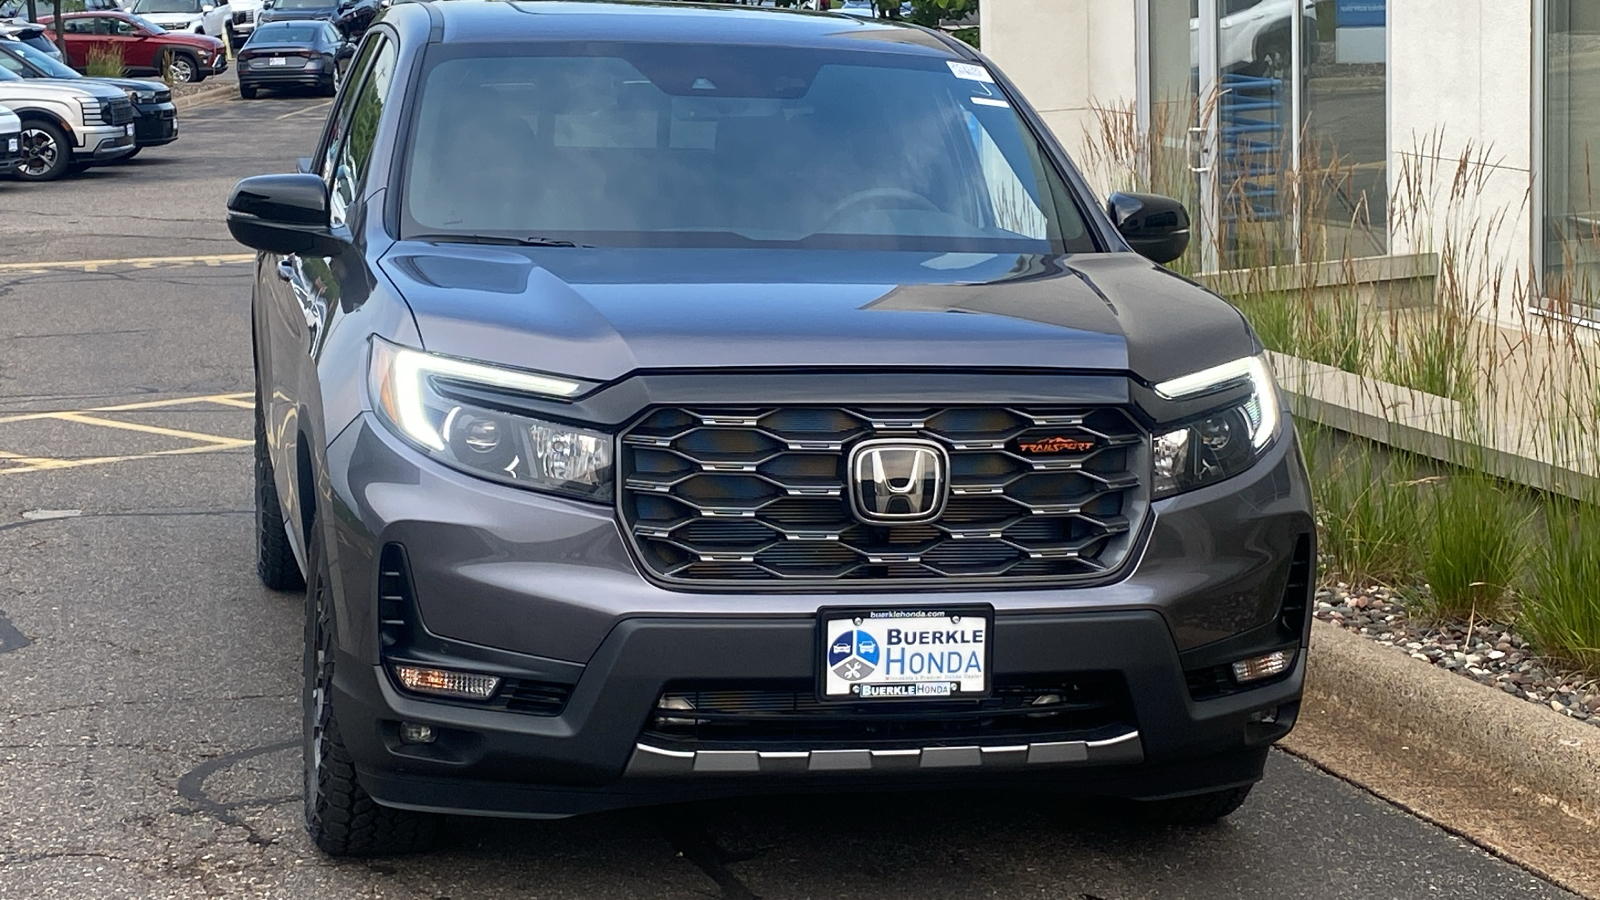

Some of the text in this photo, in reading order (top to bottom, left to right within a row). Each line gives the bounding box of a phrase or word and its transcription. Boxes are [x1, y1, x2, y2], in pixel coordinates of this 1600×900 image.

[1019, 442, 1094, 453] TRAILSPORT
[870, 610, 946, 619] buerklehonda.com
[886, 628, 984, 646] BUERKLE
[885, 647, 982, 675] HONDA
[862, 684, 949, 696] BUERKLE HONDA
